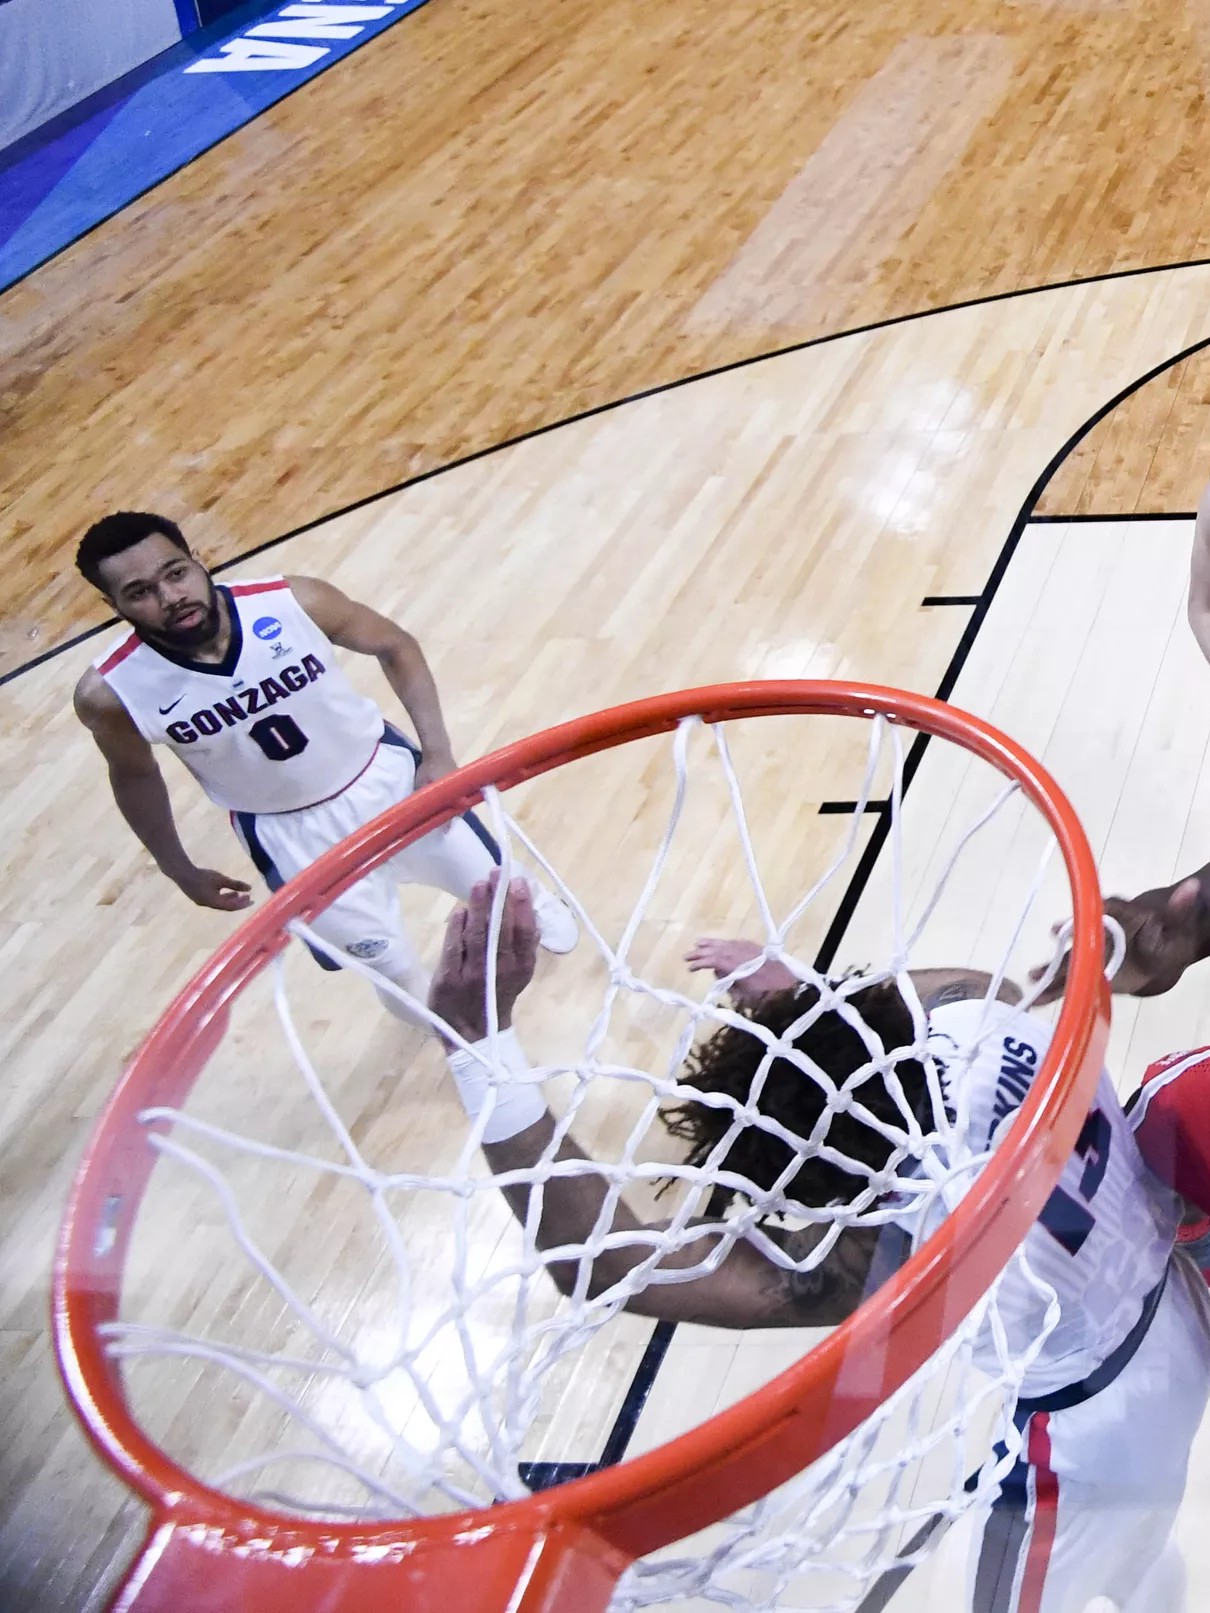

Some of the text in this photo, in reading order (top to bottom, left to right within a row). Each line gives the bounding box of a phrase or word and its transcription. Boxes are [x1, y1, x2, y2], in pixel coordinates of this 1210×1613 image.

[165, 653, 327, 744] GONZAGA
[248, 713, 310, 762] 0
[983, 1035, 1037, 1152] KINS
